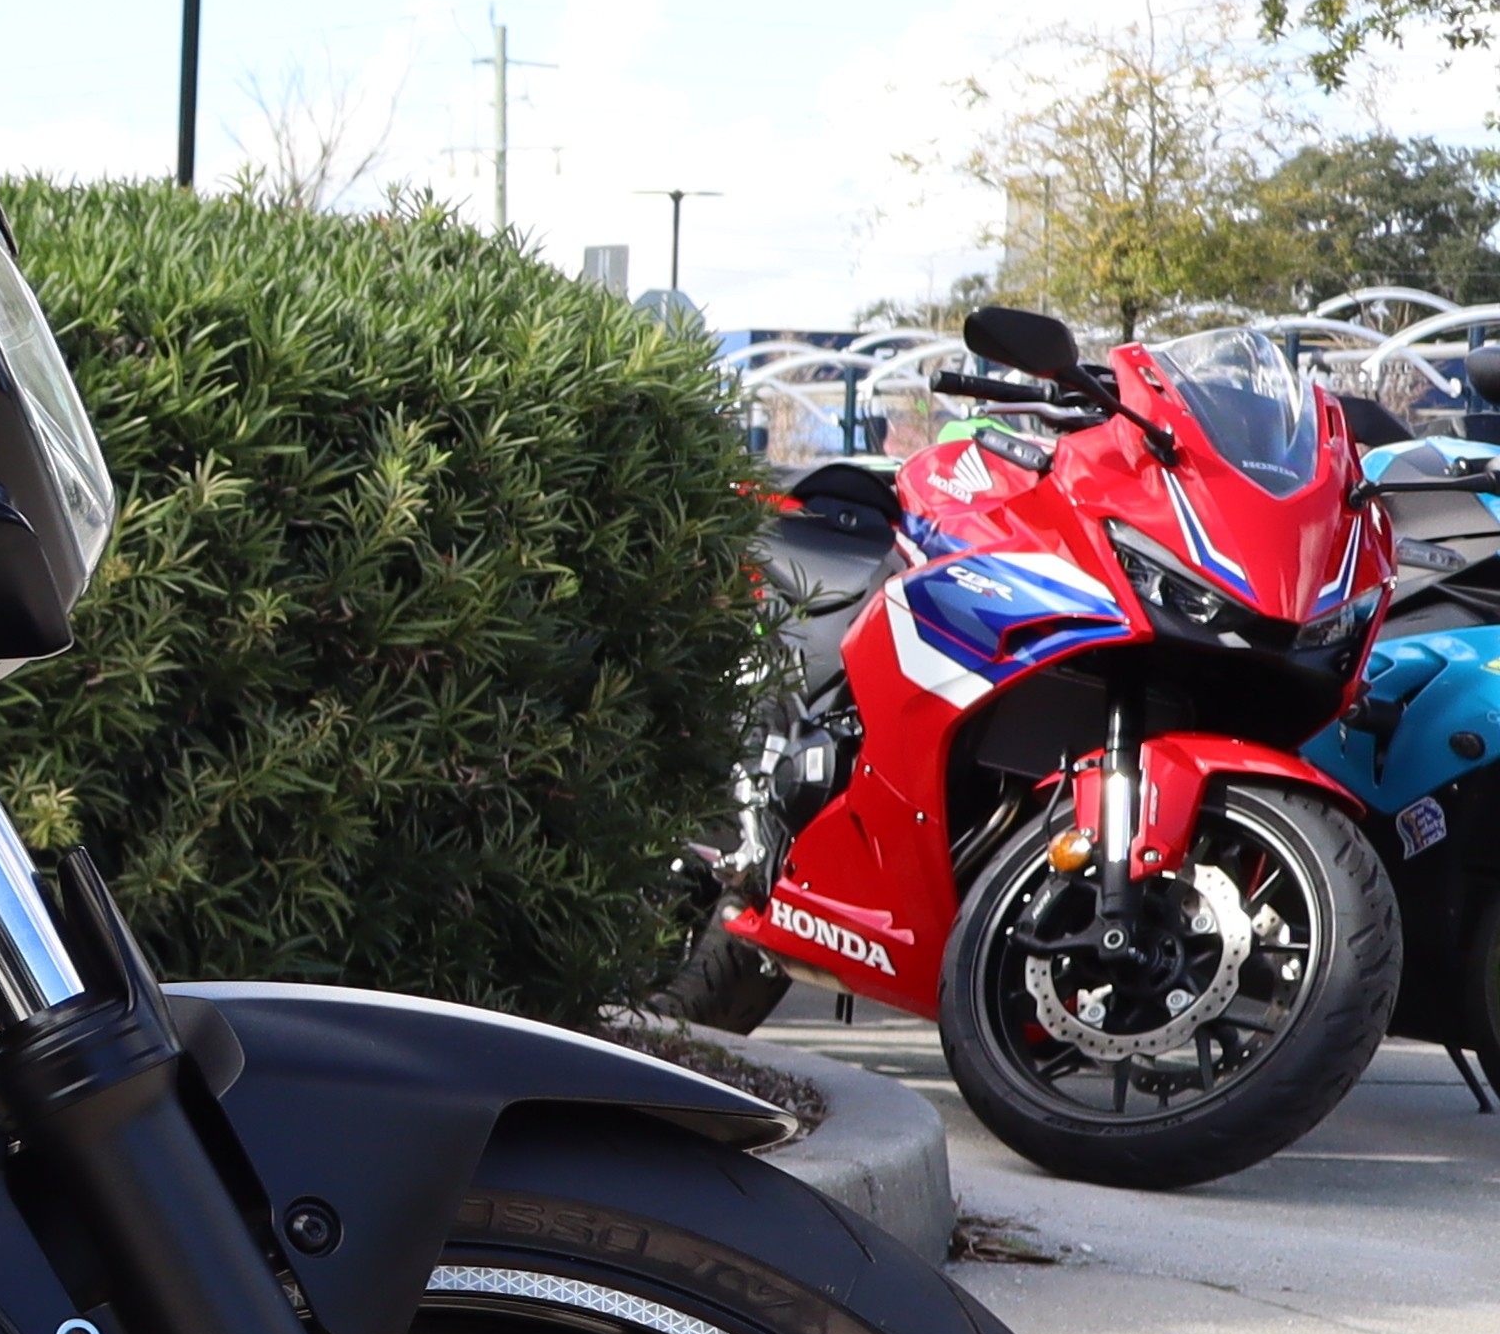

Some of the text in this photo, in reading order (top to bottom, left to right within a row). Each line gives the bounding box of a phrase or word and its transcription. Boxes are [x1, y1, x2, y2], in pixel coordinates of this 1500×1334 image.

[1243, 460, 1299, 479] HONDA
[927, 473, 972, 504] HONDA
[770, 900, 896, 975] HONDA
